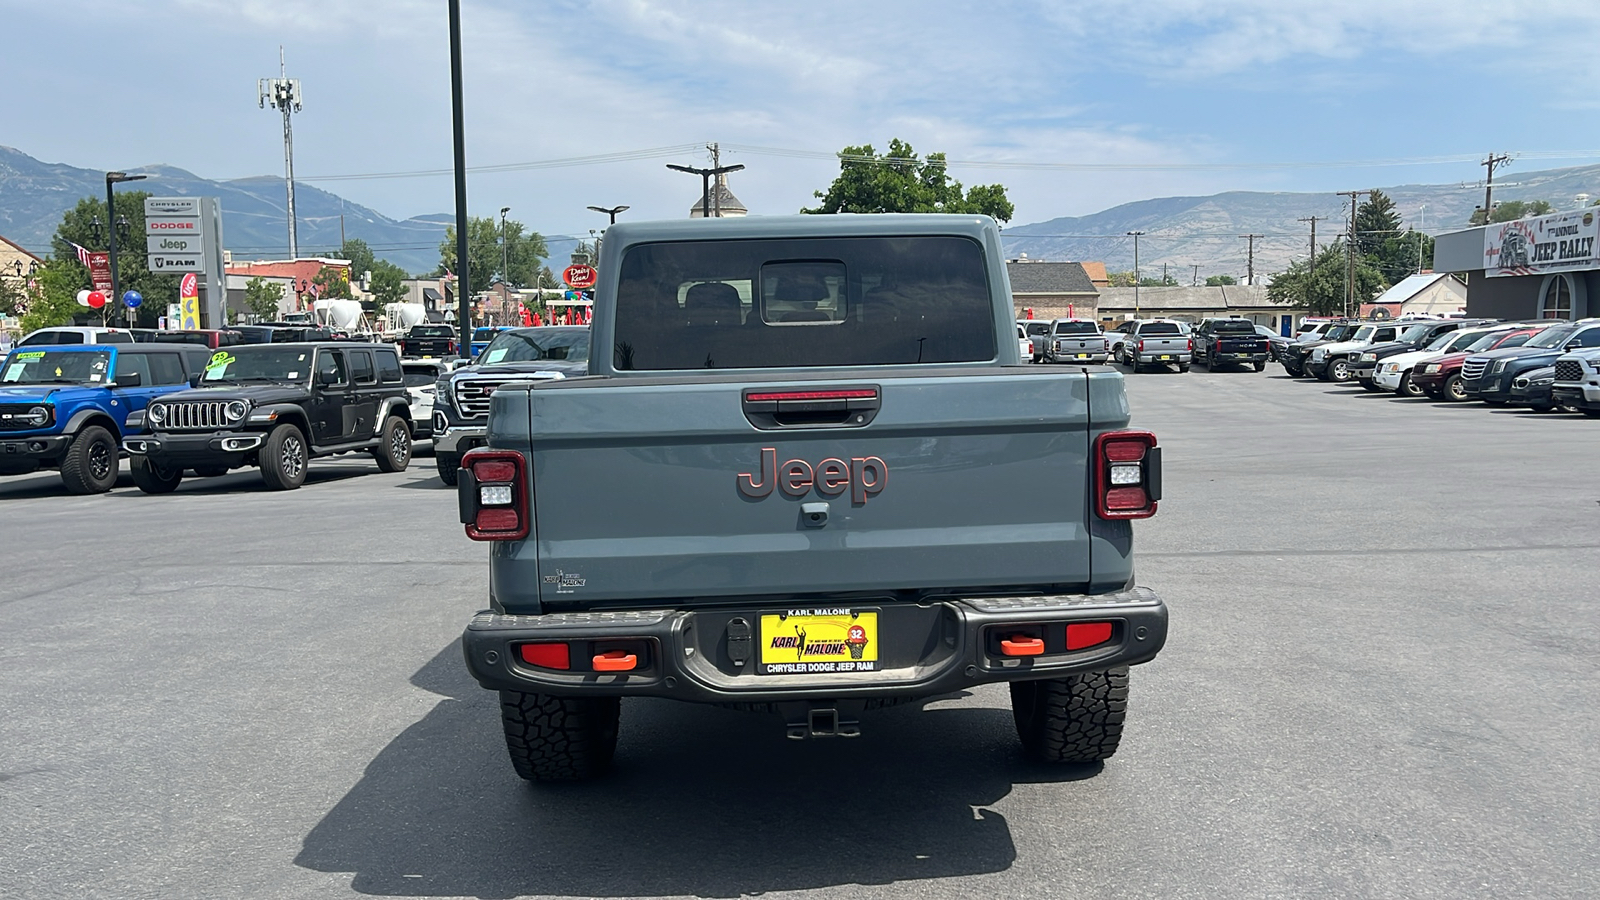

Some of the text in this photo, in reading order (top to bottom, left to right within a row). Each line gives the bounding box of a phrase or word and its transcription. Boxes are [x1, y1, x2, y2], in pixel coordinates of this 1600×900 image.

[1555, 224, 1579, 237] ANNUAL
[160, 238, 187, 251] Jeep
[1531, 236, 1594, 262] JEEP RALLY
[569, 267, 590, 280] Dairy
[570, 274, 587, 285] Keen
[183, 276, 196, 295] USED
[737, 447, 889, 504] Jeep
[814, 608, 851, 616] MALONE
[851, 629, 862, 639] 32
[771, 637, 799, 649] KARL
[804, 643, 846, 656] MALONE
[767, 661, 874, 673] CHRYSLER DODGE JEEP RAM
